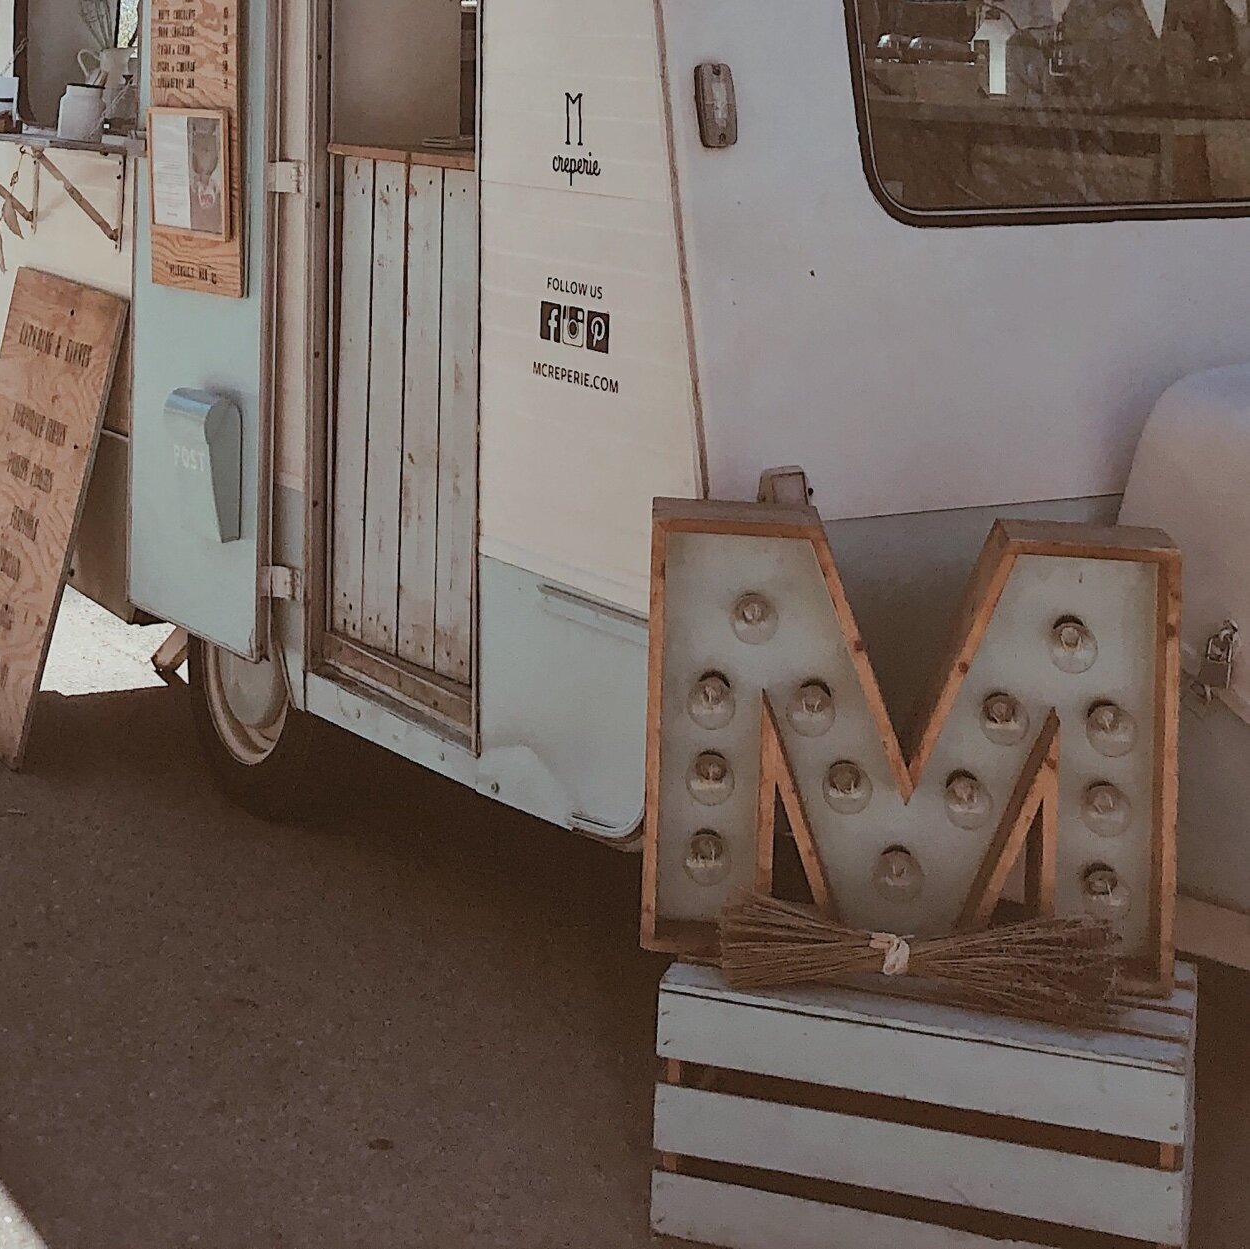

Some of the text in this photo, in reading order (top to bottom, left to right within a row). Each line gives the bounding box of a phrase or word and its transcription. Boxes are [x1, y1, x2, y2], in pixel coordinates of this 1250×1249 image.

[564, 91, 584, 147] M
[551, 151, 602, 187] creperie
[546, 276, 603, 300] FOLLOW US
[532, 361, 620, 395] MCREPERIE.COM
